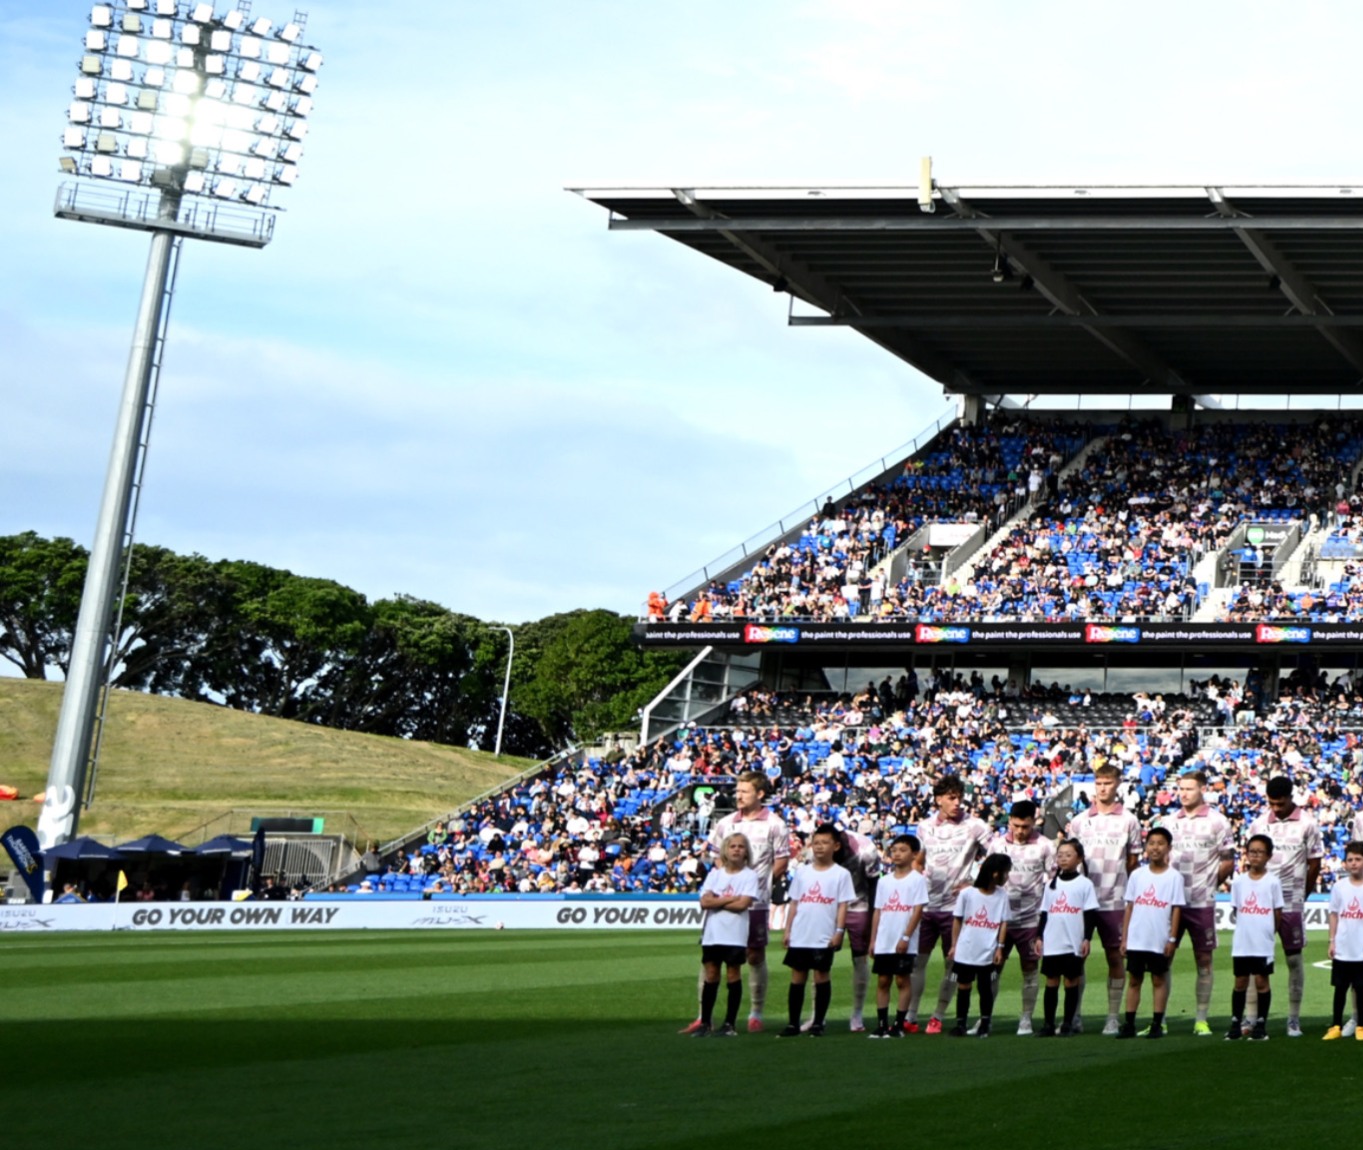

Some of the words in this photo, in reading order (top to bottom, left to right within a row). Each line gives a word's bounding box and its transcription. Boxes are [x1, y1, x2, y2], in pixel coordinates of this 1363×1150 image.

[664, 631, 676, 640] the
[678, 631, 724, 641] professionals
[726, 632, 739, 640] use
[748, 627, 796, 640] Resene
[801, 631, 813, 640] the
[815, 631, 833, 641] paint
[835, 631, 848, 640] the
[849, 631, 896, 641] professionals
[897, 632, 911, 640] use
[919, 627, 967, 640] Resene
[972, 631, 984, 640] the
[985, 631, 1004, 641] paint
[1006, 631, 1018, 640] the
[1020, 631, 1066, 641] professionals
[1068, 632, 1081, 640] use
[1089, 628, 1137, 641] Resene
[1259, 628, 1307, 641] Resene
[1313, 631, 1325, 640] the
[1326, 631, 1345, 641] paint
[1347, 631, 1359, 640] the
[132, 908, 163, 925] GO
[168, 908, 226, 925] YOUR
[230, 907, 282, 924] OWN
[290, 907, 340, 924] WAY
[432, 905, 468, 914] ISUZU
[556, 907, 587, 924] GO
[592, 907, 650, 924] YOUR
[652, 908, 704, 925] OWN
[965, 916, 1000, 929] Anchor
